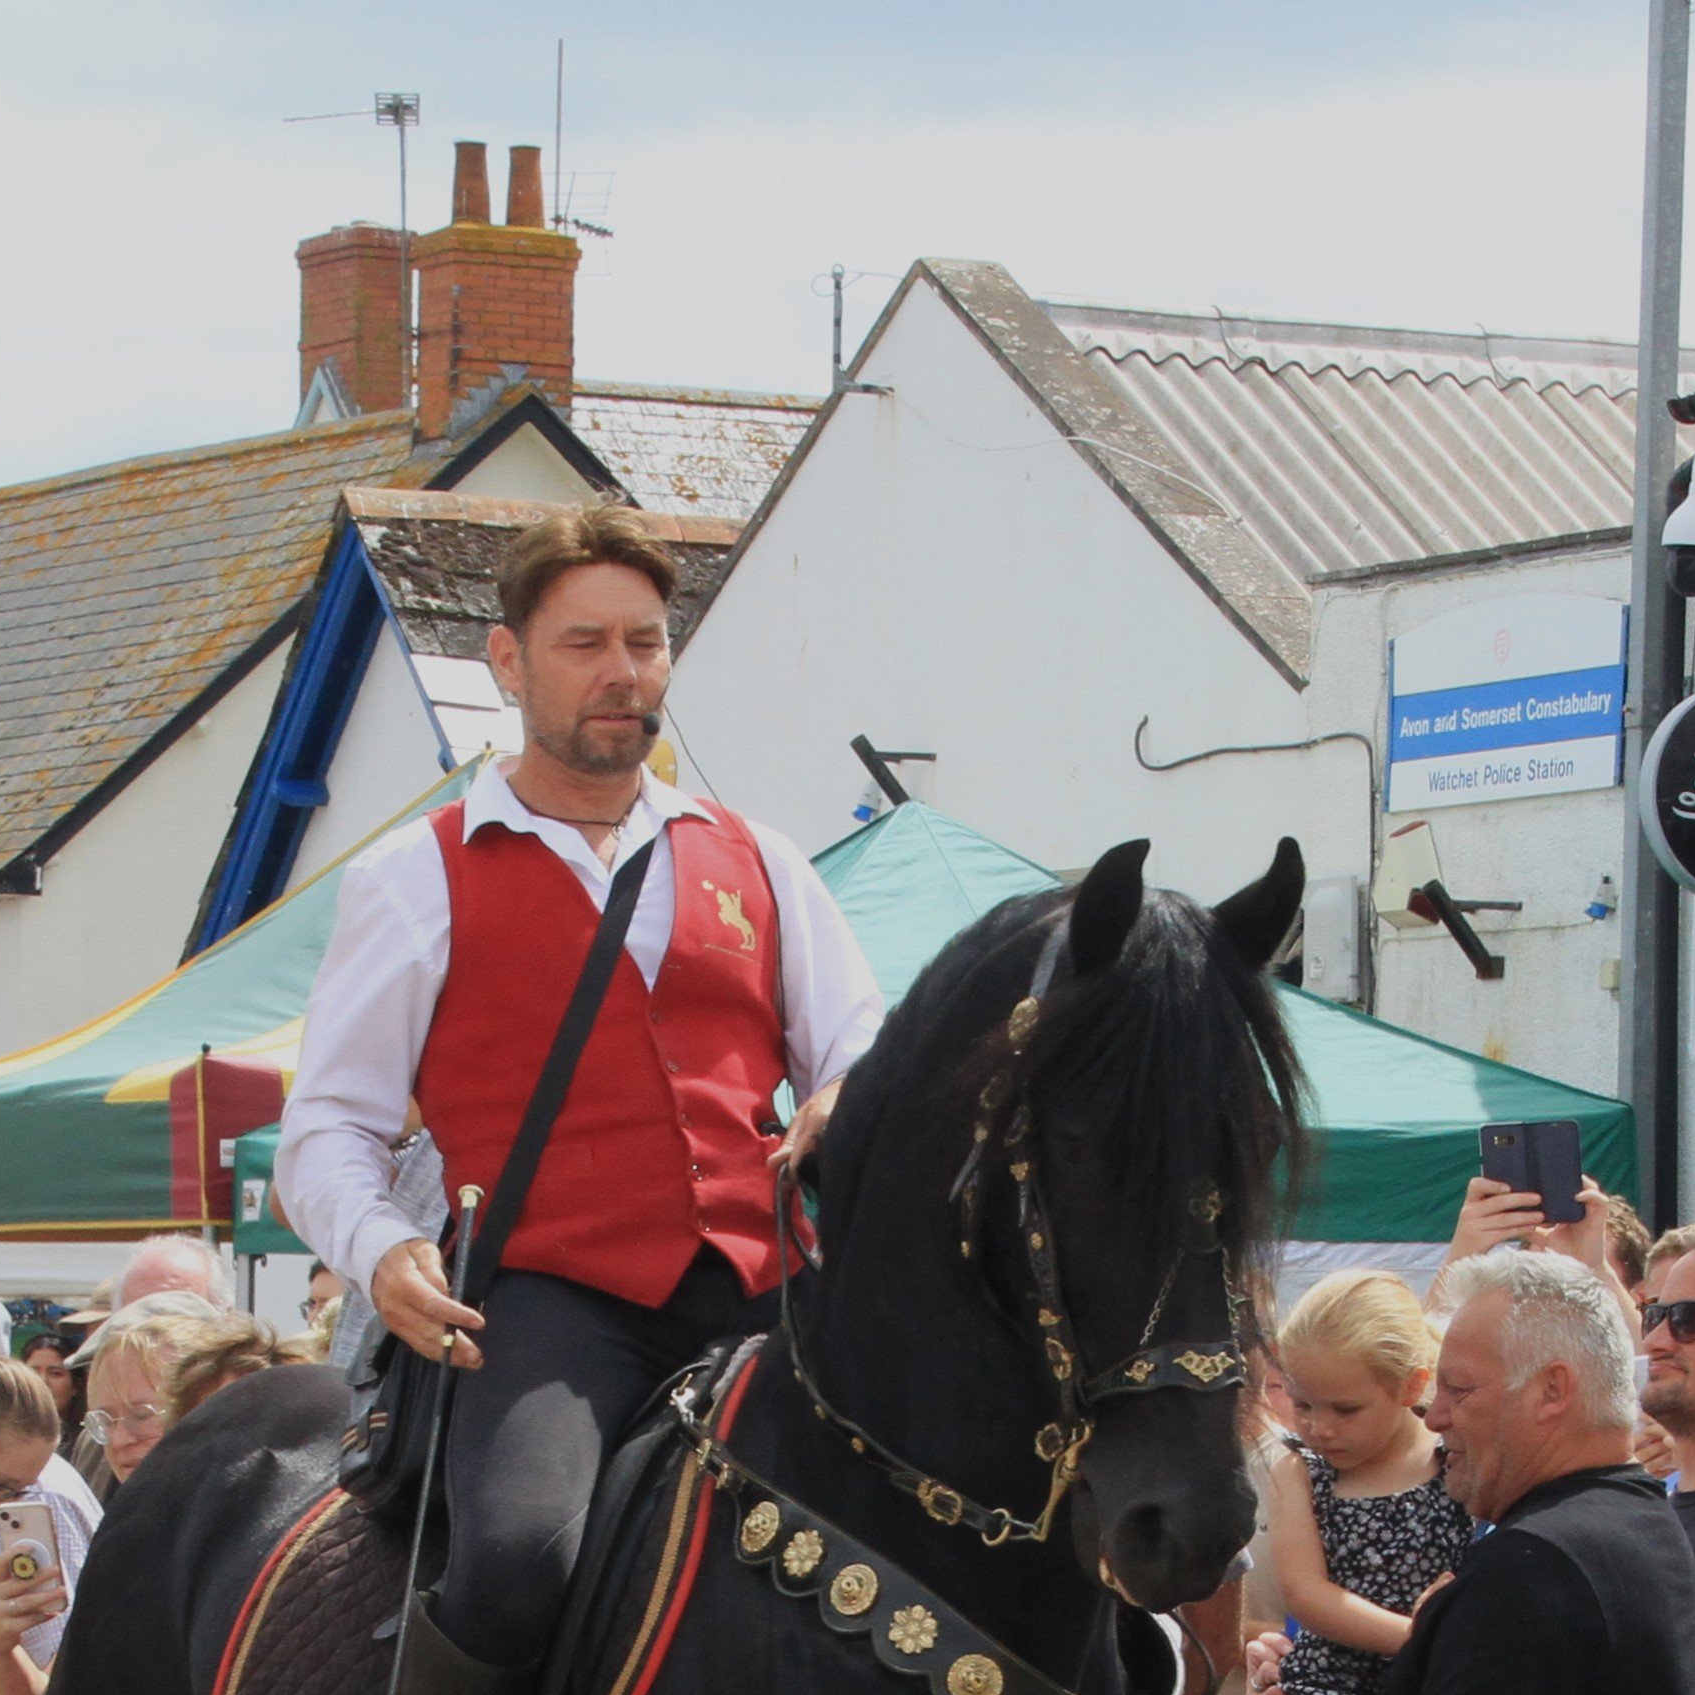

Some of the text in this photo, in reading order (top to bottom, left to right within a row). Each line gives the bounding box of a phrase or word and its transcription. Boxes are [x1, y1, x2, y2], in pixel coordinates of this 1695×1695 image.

[1399, 690, 1612, 738] Avon and Somerset Constabulary
[1428, 757, 1574, 792] Watchet Police Station
